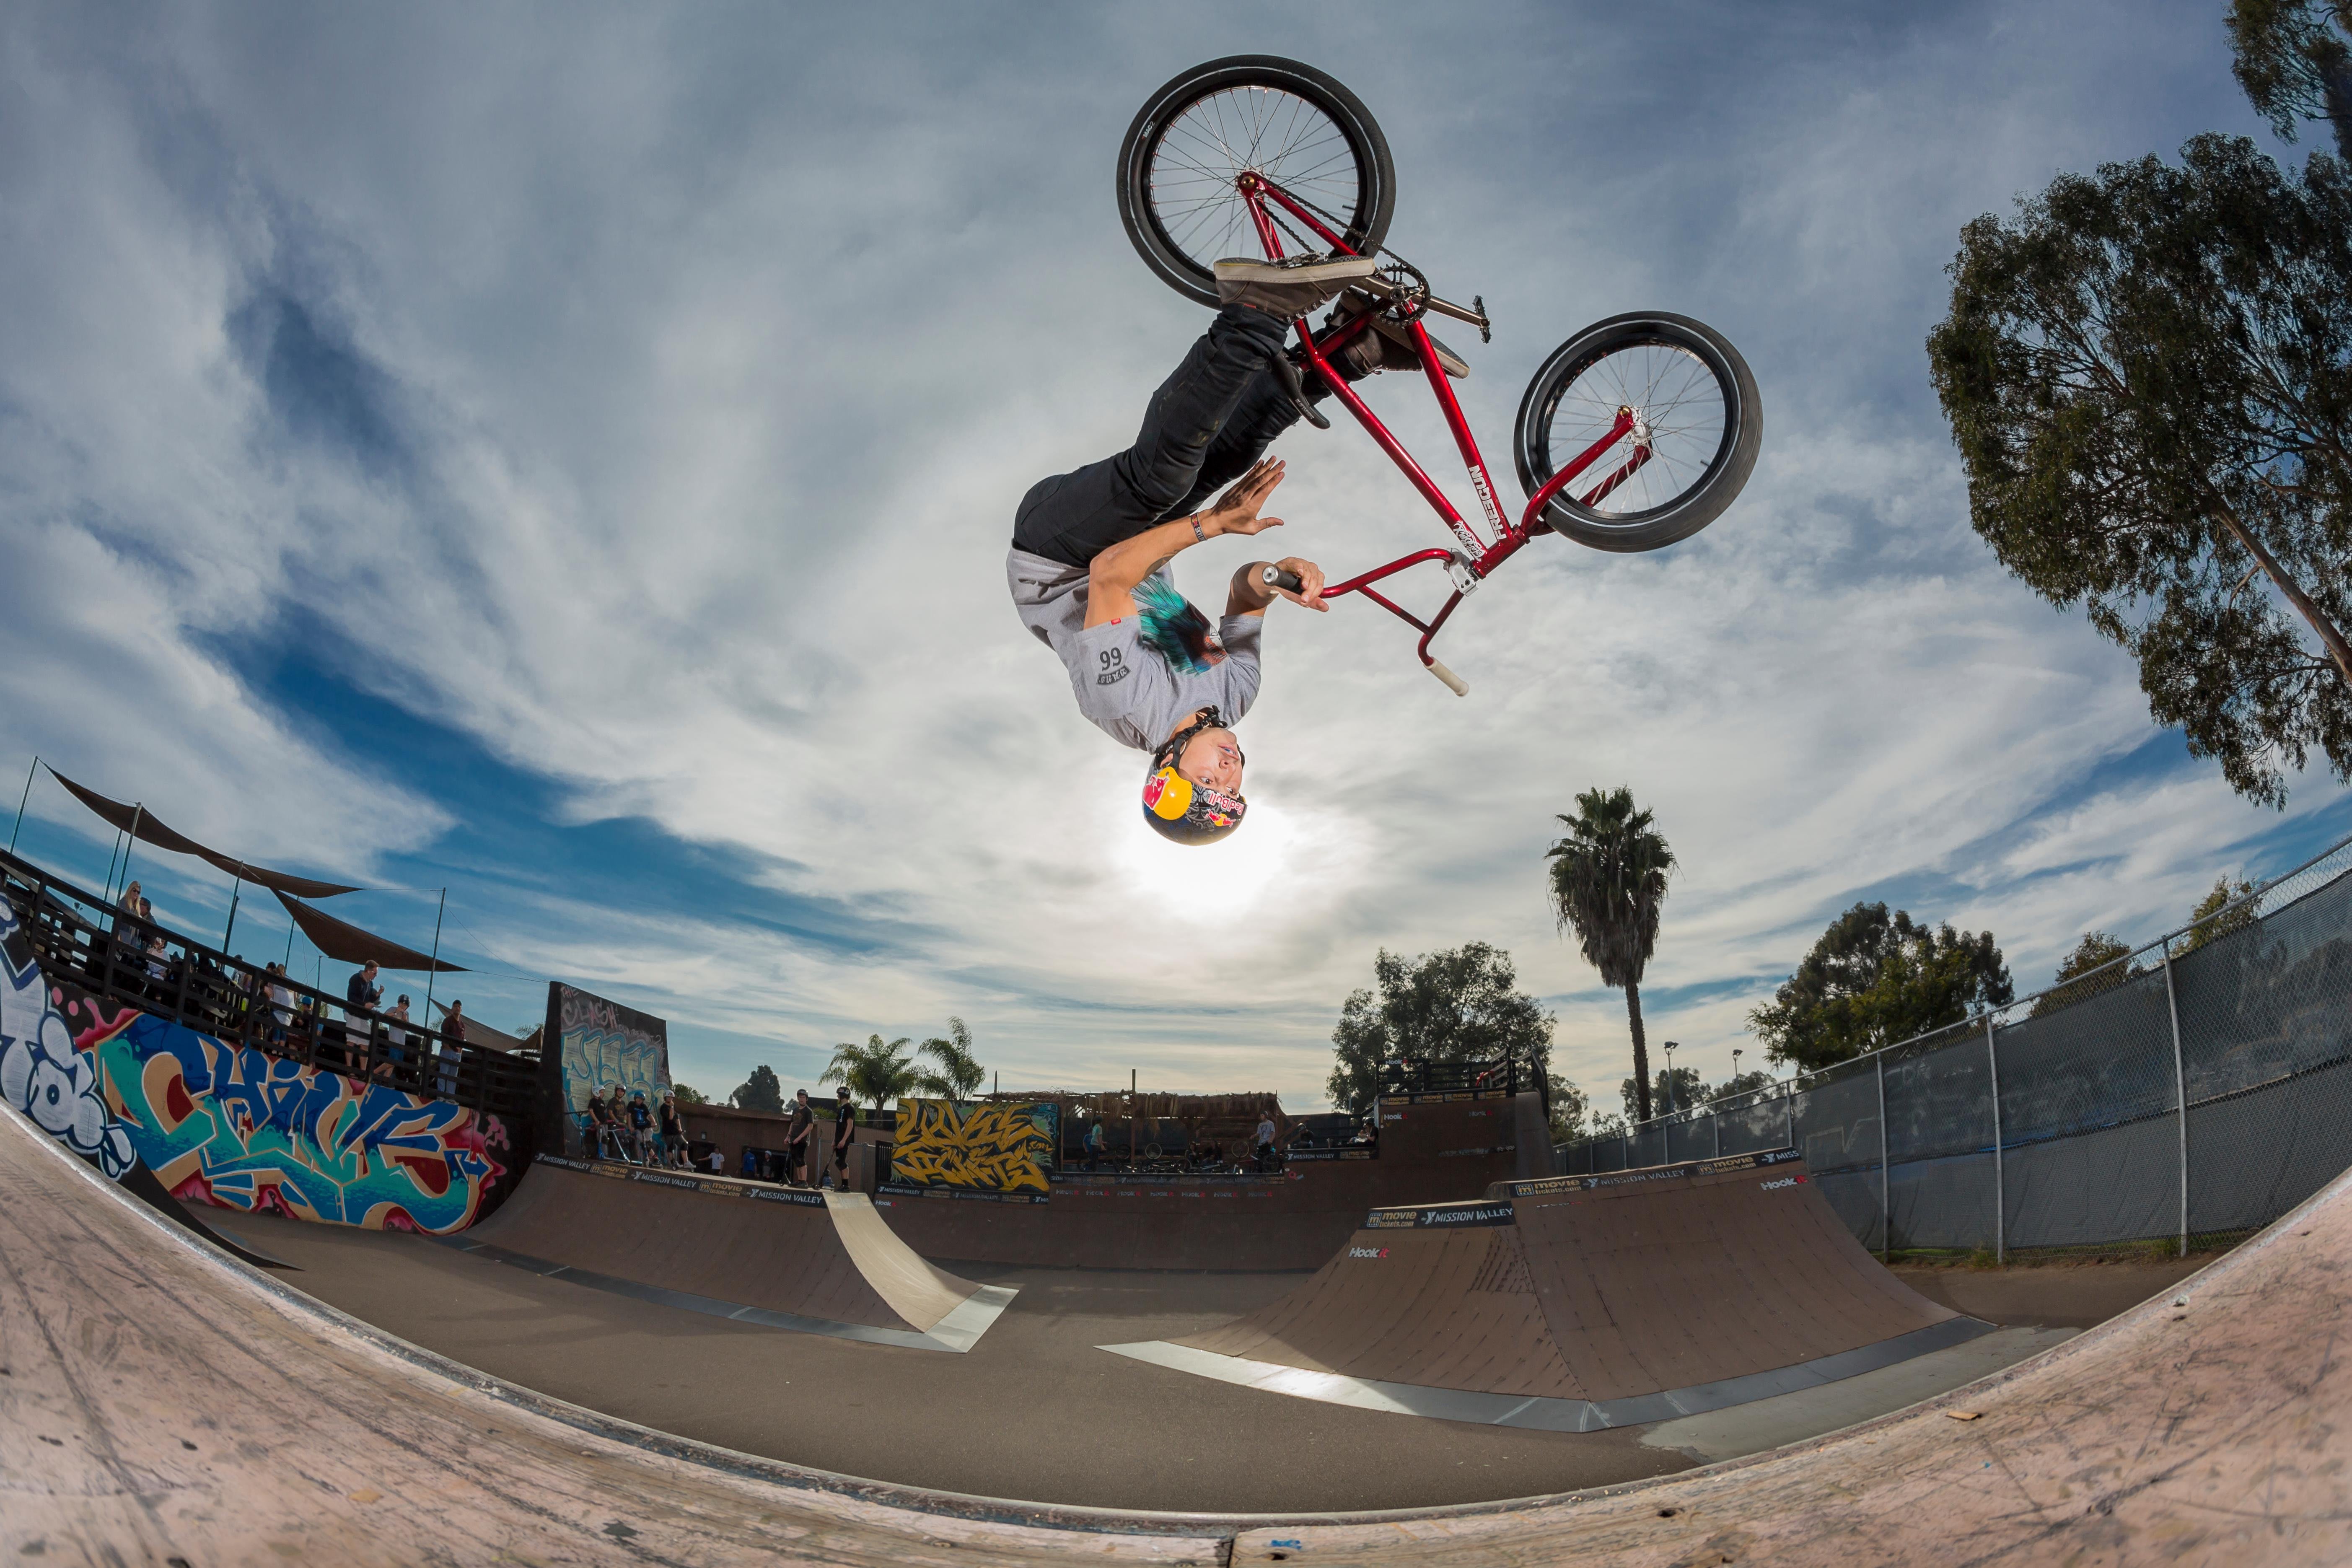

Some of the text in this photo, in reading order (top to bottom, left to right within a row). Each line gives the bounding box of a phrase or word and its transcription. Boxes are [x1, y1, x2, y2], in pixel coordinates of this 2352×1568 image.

[1208, 793, 1244, 815] Red Bull
[1777, 1150, 1799, 1160] MISS
[543, 1156, 567, 1165] MISSION
[569, 1161, 591, 1169] VALLEY
[1713, 1156, 1754, 1168] movie
[602, 1165, 628, 1174] movie
[1715, 1163, 1756, 1173] tickets.com
[642, 1174, 670, 1184] MISSION
[671, 1178, 697, 1187] VALLEY
[1601, 1175, 1646, 1185] MISSION
[1647, 1169, 1685, 1180] VALLEY
[712, 1182, 742, 1192] movie
[1534, 1179, 1580, 1189] movie
[1535, 1186, 1582, 1195] tickets.com
[759, 1191, 792, 1201] MISSION
[793, 1195, 823, 1204] VALLEY
[1382, 1211, 1417, 1220] movie
[1435, 1211, 1474, 1222] MISSION
[1476, 1208, 1513, 1220] VALLEY
[1348, 1247, 1390, 1258] Hookit
